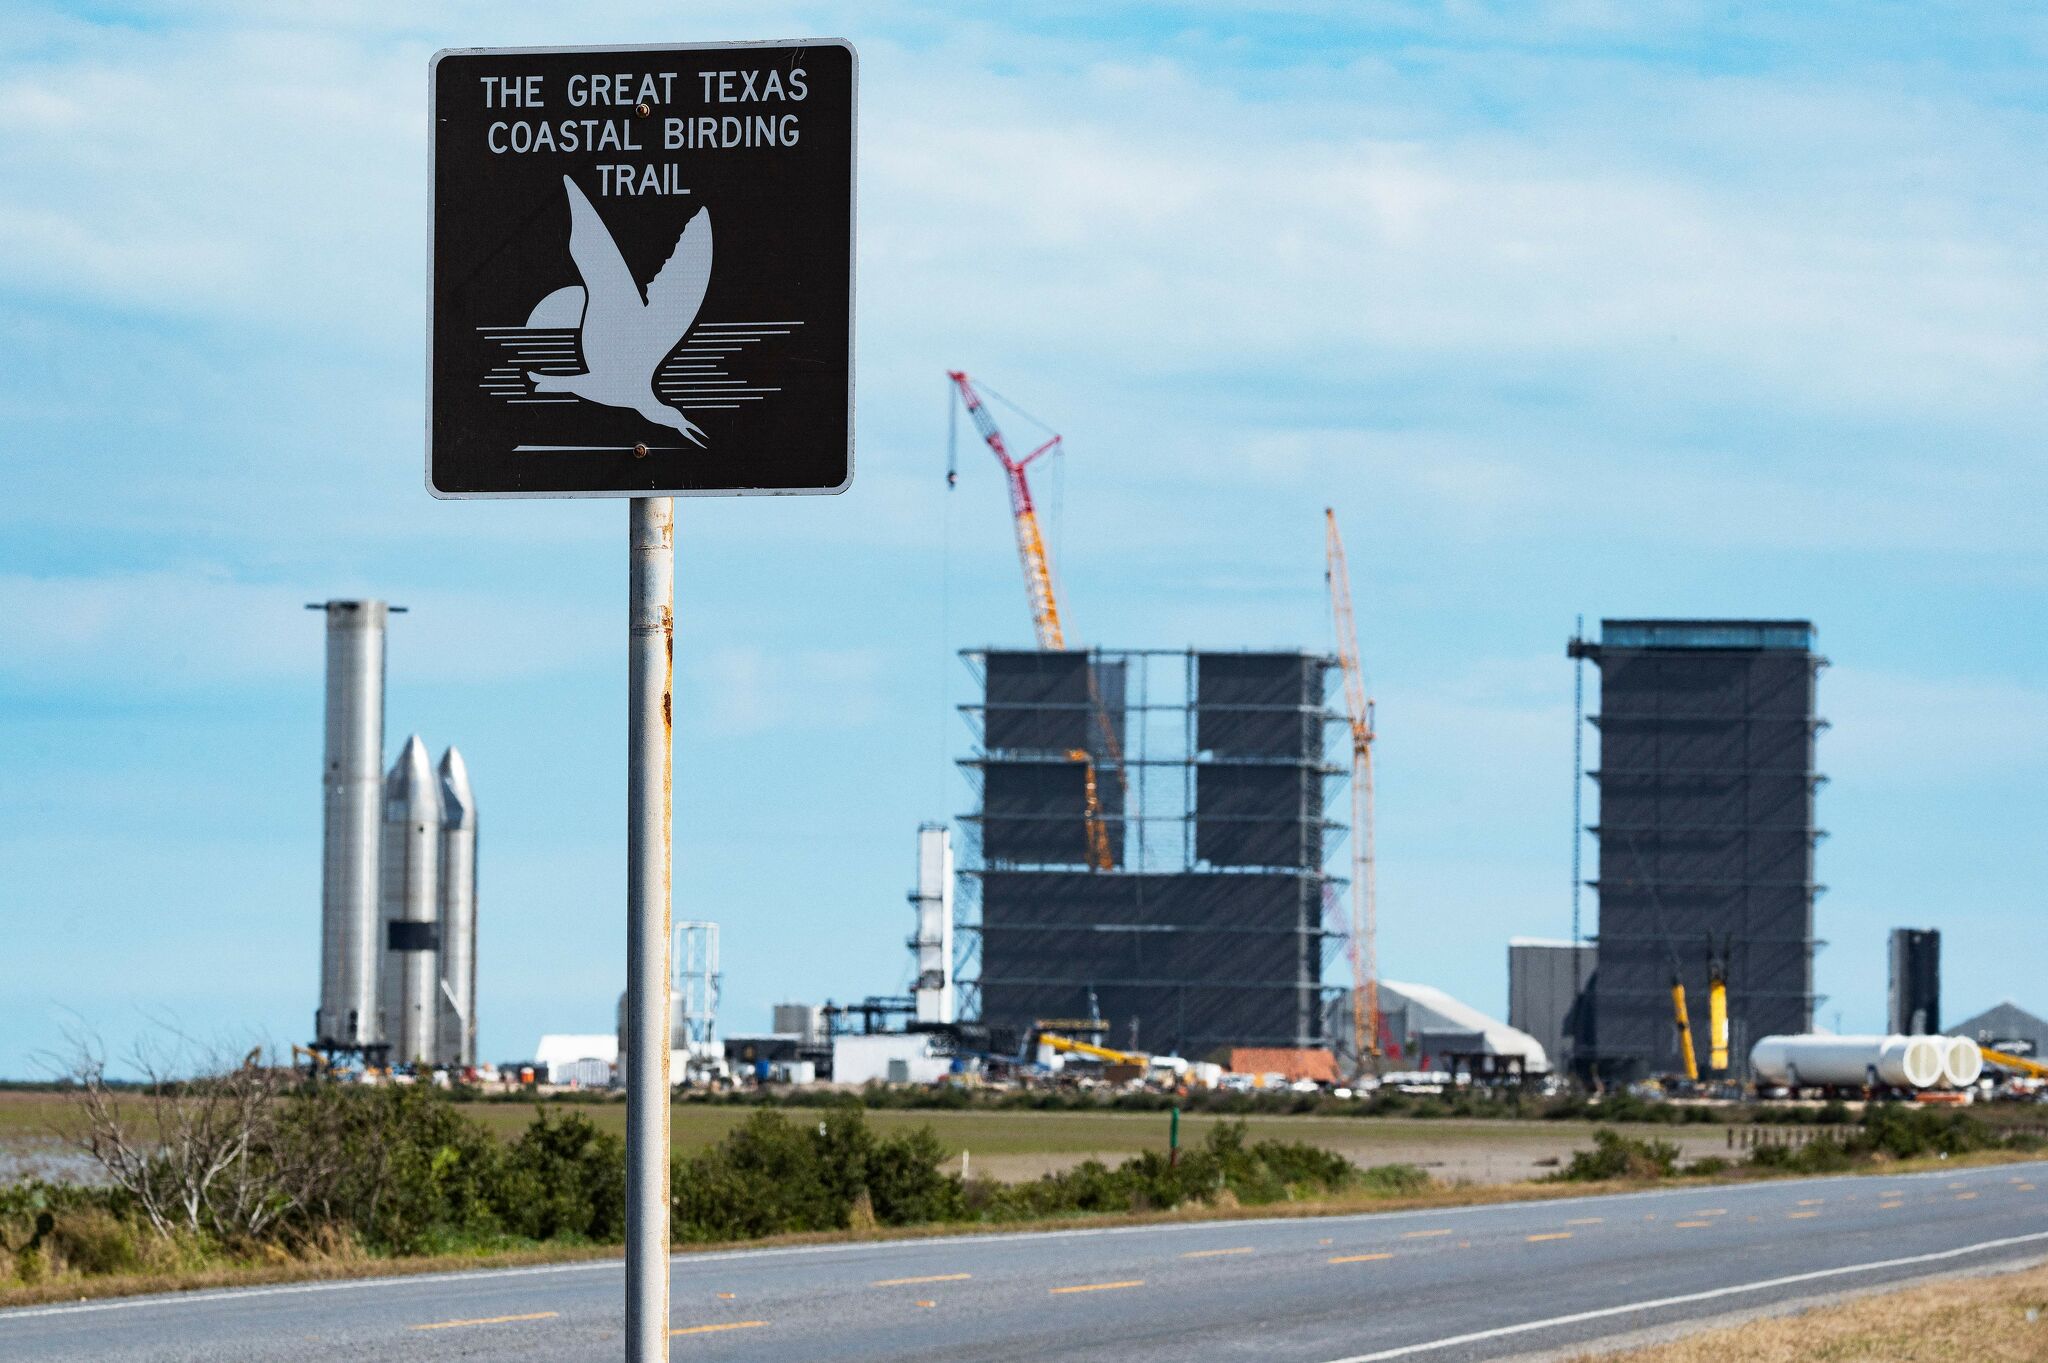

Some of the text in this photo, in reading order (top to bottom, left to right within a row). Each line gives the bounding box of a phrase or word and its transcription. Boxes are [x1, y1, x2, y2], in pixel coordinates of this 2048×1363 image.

[481, 68, 808, 108] THE GREAT TEXAS
[487, 114, 800, 154] COASTAL BIRDING
[596, 163, 691, 197] TRAIL
